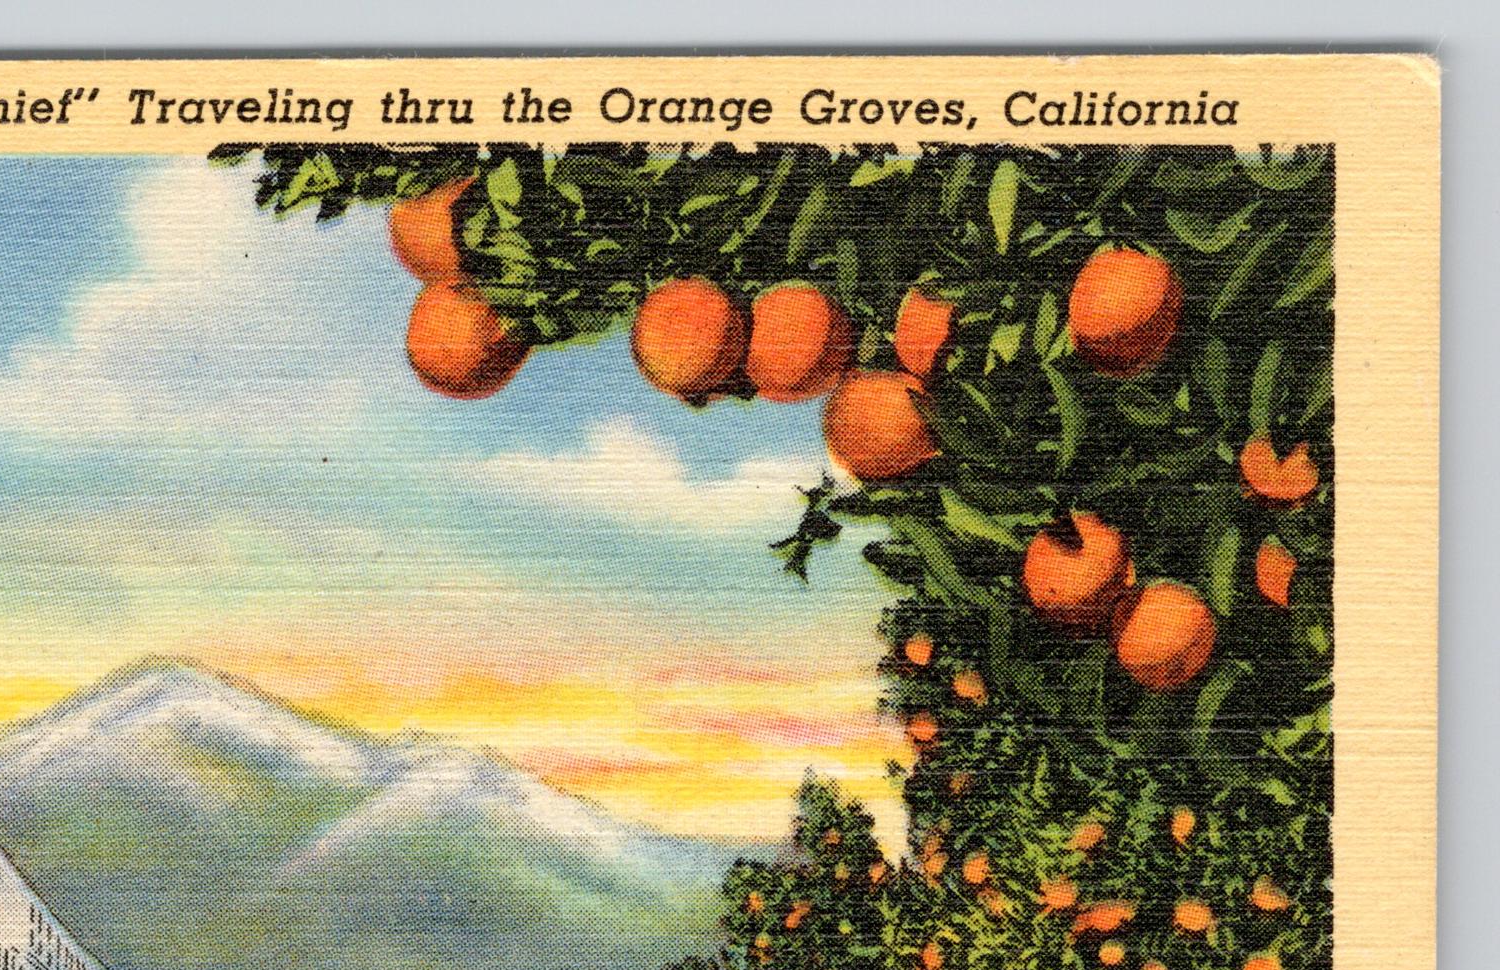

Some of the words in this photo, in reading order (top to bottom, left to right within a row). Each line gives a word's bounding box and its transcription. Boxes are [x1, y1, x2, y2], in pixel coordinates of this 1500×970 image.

[128, 88, 354, 132] Traveling
[381, 88, 474, 125] thru
[502, 87, 572, 124] the
[599, 87, 773, 132] Orange
[800, 88, 978, 130] Groves,
[1004, 90, 1240, 127] California
